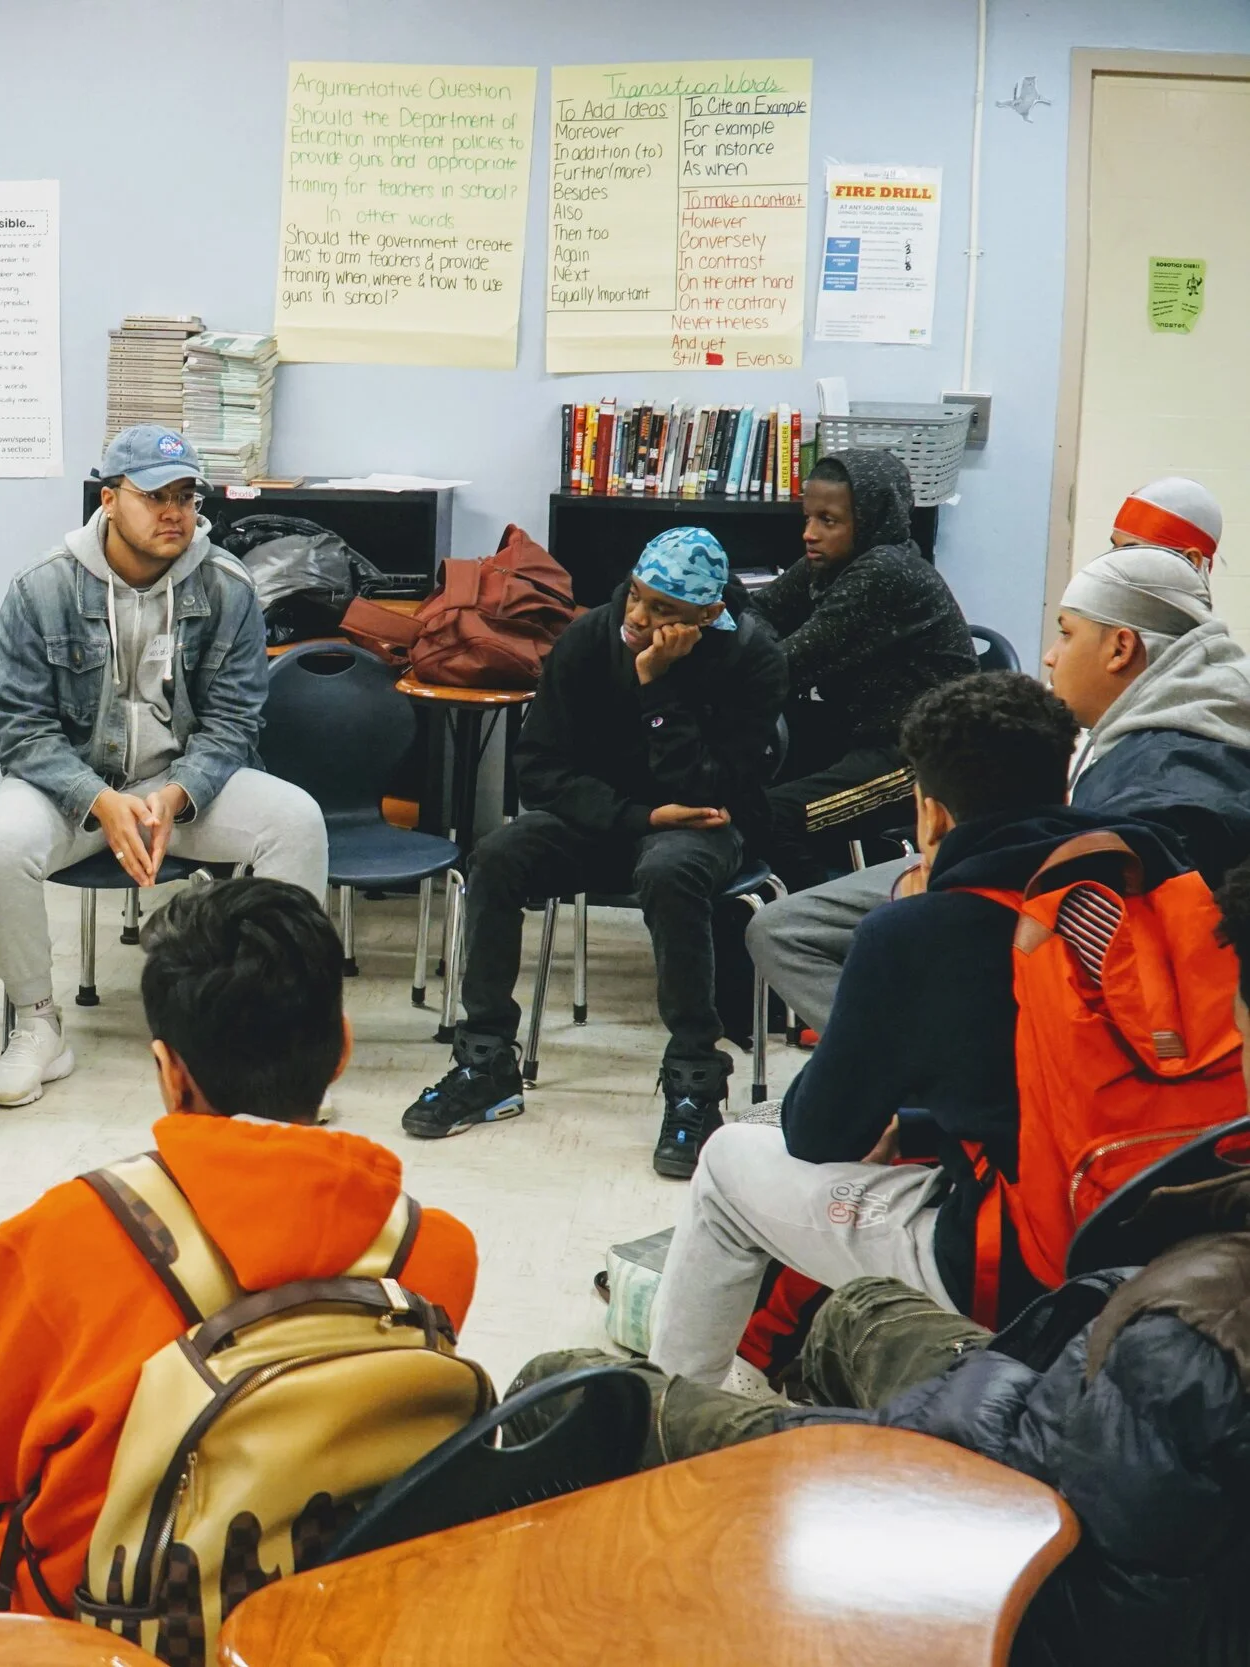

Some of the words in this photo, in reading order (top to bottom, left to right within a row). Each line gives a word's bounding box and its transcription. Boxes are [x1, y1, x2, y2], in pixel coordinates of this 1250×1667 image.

[292, 72, 423, 105] Argumentative
[428, 77, 512, 101] Question
[603, 72, 719, 99] Transition
[723, 70, 787, 93] Words
[557, 99, 575, 121] To
[583, 100, 615, 119] Add
[685, 96, 703, 117] To
[708, 97, 732, 114] Cite
[735, 100, 750, 113] an
[754, 95, 806, 117] Example
[292, 103, 353, 126] Should
[361, 109, 390, 127] the
[400, 107, 495, 133] Department
[501, 113, 517, 129] of
[291, 126, 364, 147] Education
[373, 132, 445, 151] implement
[452, 135, 506, 151] policies
[509, 135, 524, 150] to
[555, 124, 624, 141] Moreover
[684, 120, 710, 137] For
[715, 120, 774, 140] example
[554, 143, 569, 160] In
[572, 146, 630, 160] addition
[635, 143, 663, 159] (to)
[684, 139, 708, 156] For
[715, 141, 774, 156] instance
[289, 150, 343, 171] provide
[349, 153, 384, 172] guns
[391, 154, 416, 168] and
[427, 156, 517, 173] appropriate
[683, 160, 702, 176] As
[705, 161, 747, 176] when
[554, 164, 652, 180] Further(more)
[289, 176, 338, 201] training
[345, 176, 366, 195] for
[379, 178, 434, 198] teachers
[442, 183, 453, 198] in
[461, 182, 518, 200] school?
[554, 183, 608, 201] Besides
[836, 186, 875, 197] FIRE
[880, 187, 931, 199] DRILL
[683, 191, 701, 209] To
[704, 192, 740, 208] make
[742, 195, 750, 208] a
[753, 193, 803, 208] contrast
[326, 205, 341, 224] In
[356, 209, 398, 224] other
[409, 212, 455, 229] words
[554, 204, 582, 221] Also
[682, 212, 747, 230] However
[286, 223, 339, 246] Should
[349, 230, 371, 247] the
[376, 234, 458, 250] government
[466, 238, 513, 252] create
[554, 225, 582, 240] Then
[588, 225, 609, 240] too
[680, 231, 766, 252] Conversely
[284, 246, 312, 263] laws
[318, 248, 330, 263] to
[335, 251, 360, 264] arm
[368, 252, 421, 268] teachers
[424, 253, 434, 271] &
[439, 255, 490, 271] provide
[554, 245, 589, 267] Again
[678, 251, 693, 270] In
[699, 256, 765, 270] contrast
[282, 269, 330, 286] training
[372, 273, 412, 288] where
[418, 273, 425, 288] &
[430, 275, 457, 290] how
[465, 275, 477, 291] to
[483, 280, 502, 292] use
[554, 266, 590, 281] Next
[679, 274, 698, 292] On
[703, 275, 723, 289] the
[725, 275, 757, 289] other
[762, 275, 793, 289] hand
[282, 289, 313, 309] guns
[323, 291, 335, 304] in
[345, 290, 399, 305] school?
[551, 285, 594, 308] Equally
[598, 285, 651, 302] Important
[680, 295, 700, 311] On
[705, 296, 722, 310] the
[728, 296, 786, 314] contrary
[672, 315, 768, 330] Nevertheless
[672, 335, 697, 350] And
[701, 337, 726, 354] yet
[673, 353, 700, 365] Still
[736, 352, 775, 367] Even
[778, 354, 792, 365] so
[782, 426, 790, 443] HERE
[781, 445, 789, 463] TITLE
[781, 465, 789, 488] ENTER
